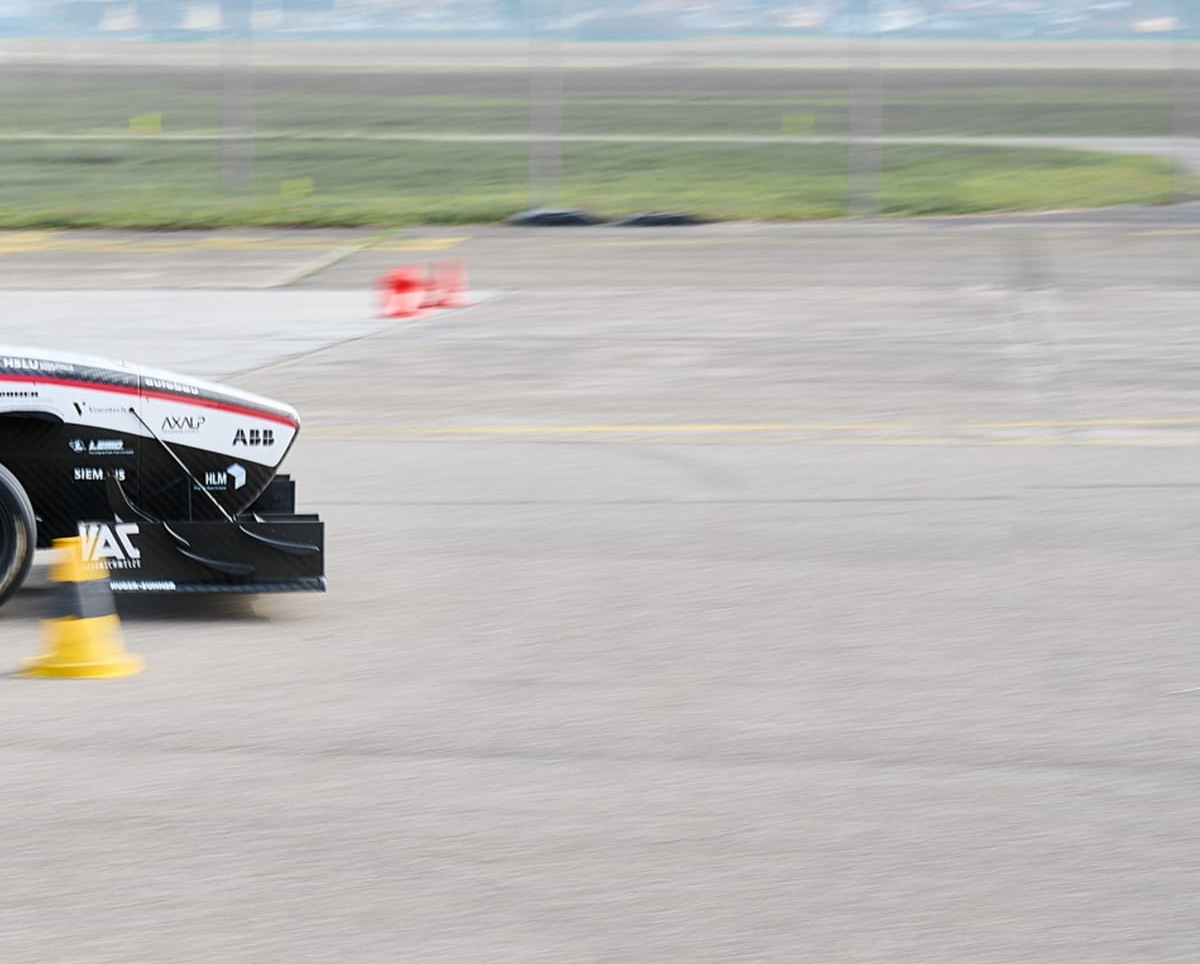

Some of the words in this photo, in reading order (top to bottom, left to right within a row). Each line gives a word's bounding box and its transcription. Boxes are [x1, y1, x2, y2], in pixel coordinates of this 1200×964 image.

[232, 428, 275, 447] ABB
[74, 468, 126, 481] SIEMS
[205, 472, 227, 485] HLM
